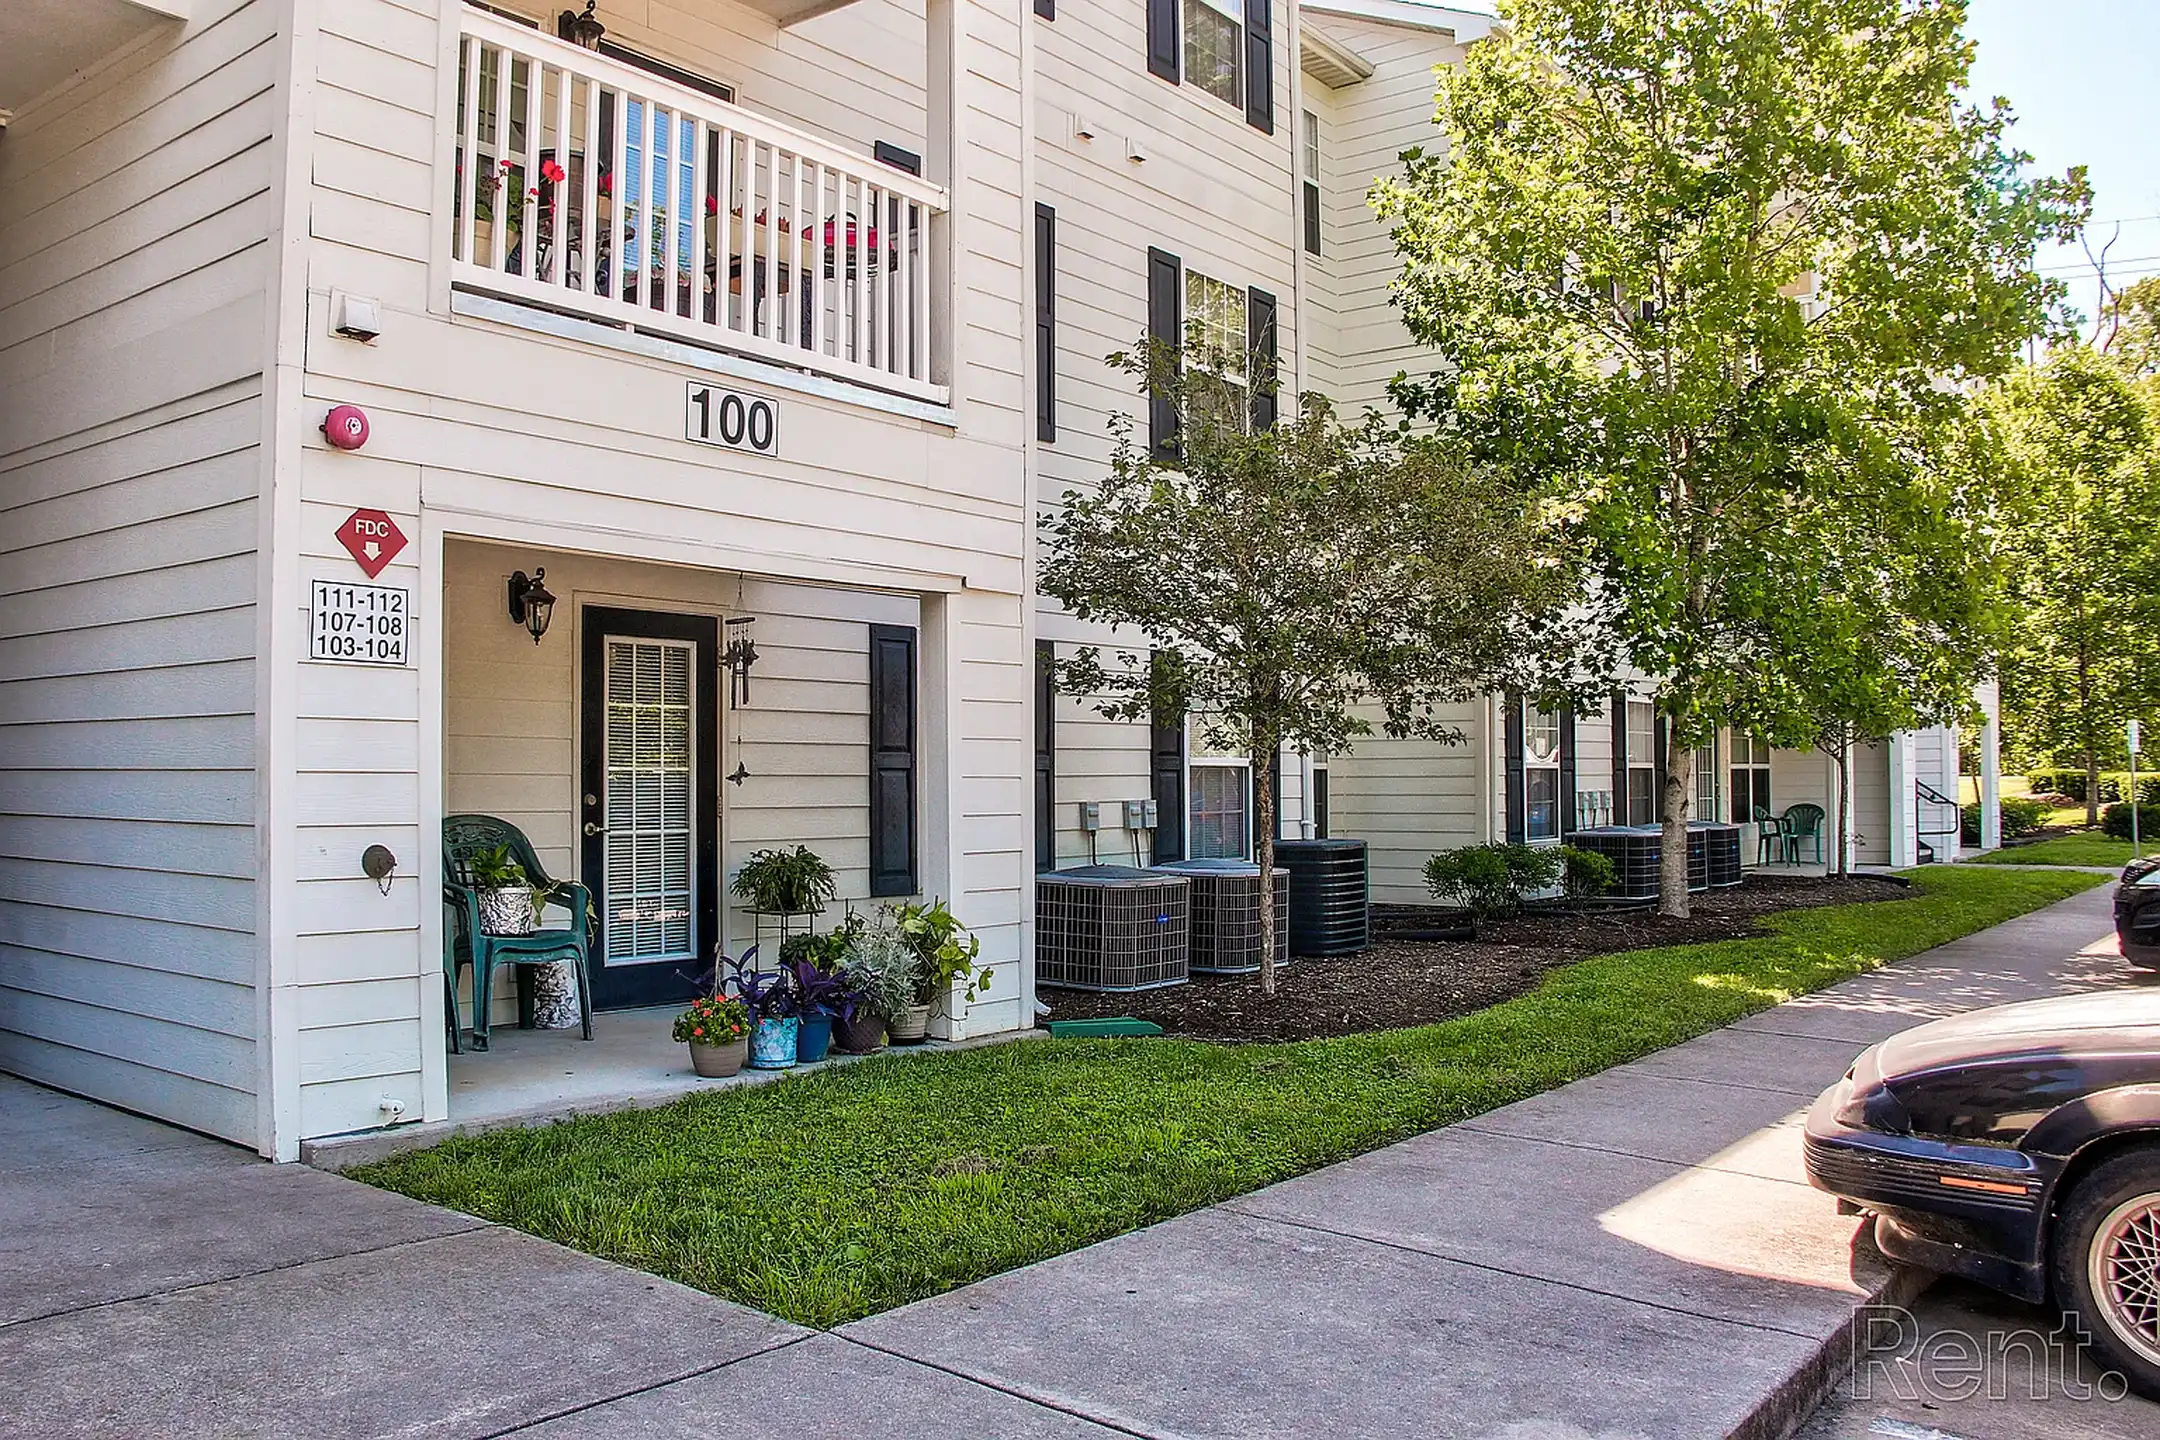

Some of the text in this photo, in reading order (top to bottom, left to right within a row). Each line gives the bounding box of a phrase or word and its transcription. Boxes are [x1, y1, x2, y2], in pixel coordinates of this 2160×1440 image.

[692, 388, 773, 451] 100
[354, 518, 389, 538] FDC
[318, 586, 403, 613] 111-112
[318, 611, 403, 637] 107-108
[317, 635, 402, 660] 103-104
